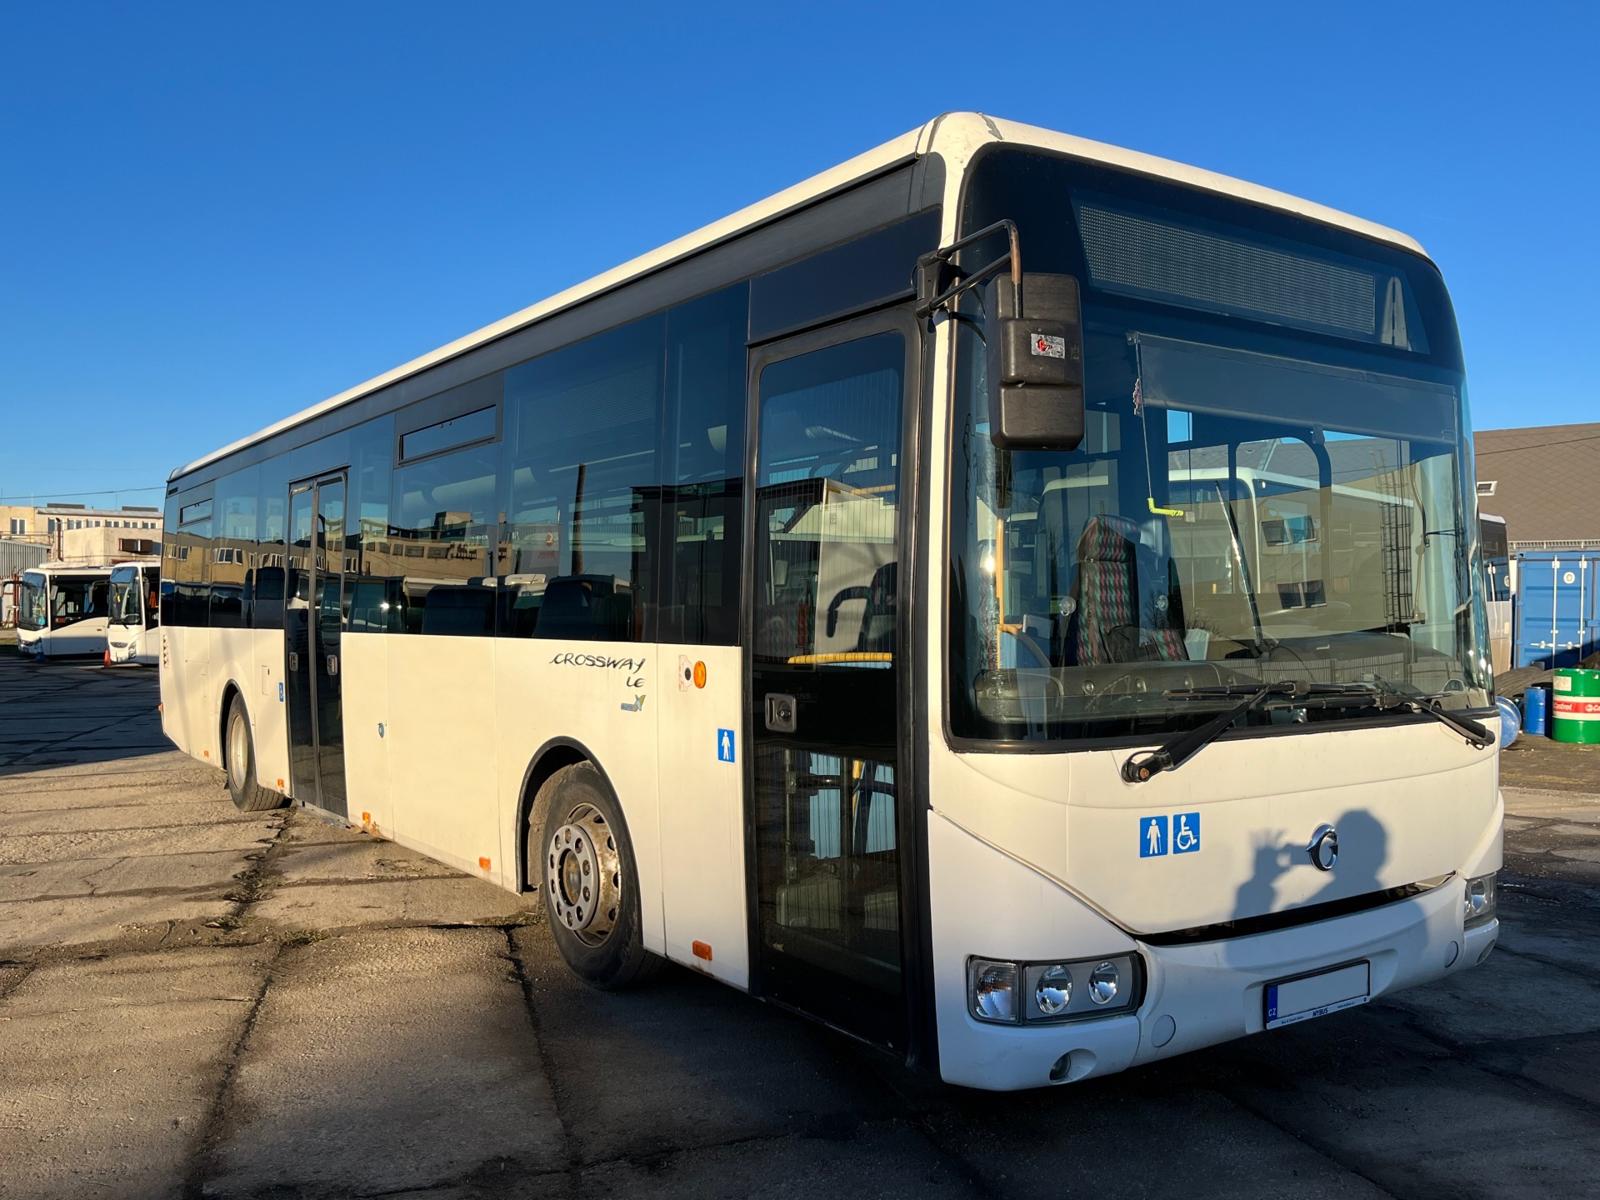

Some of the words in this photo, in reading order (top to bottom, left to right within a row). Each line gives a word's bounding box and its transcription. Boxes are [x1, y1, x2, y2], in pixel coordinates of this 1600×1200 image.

[549, 653, 646, 674] CROSSWAY
[626, 676, 645, 687] LE
[1268, 1007, 1277, 1017] CZ
